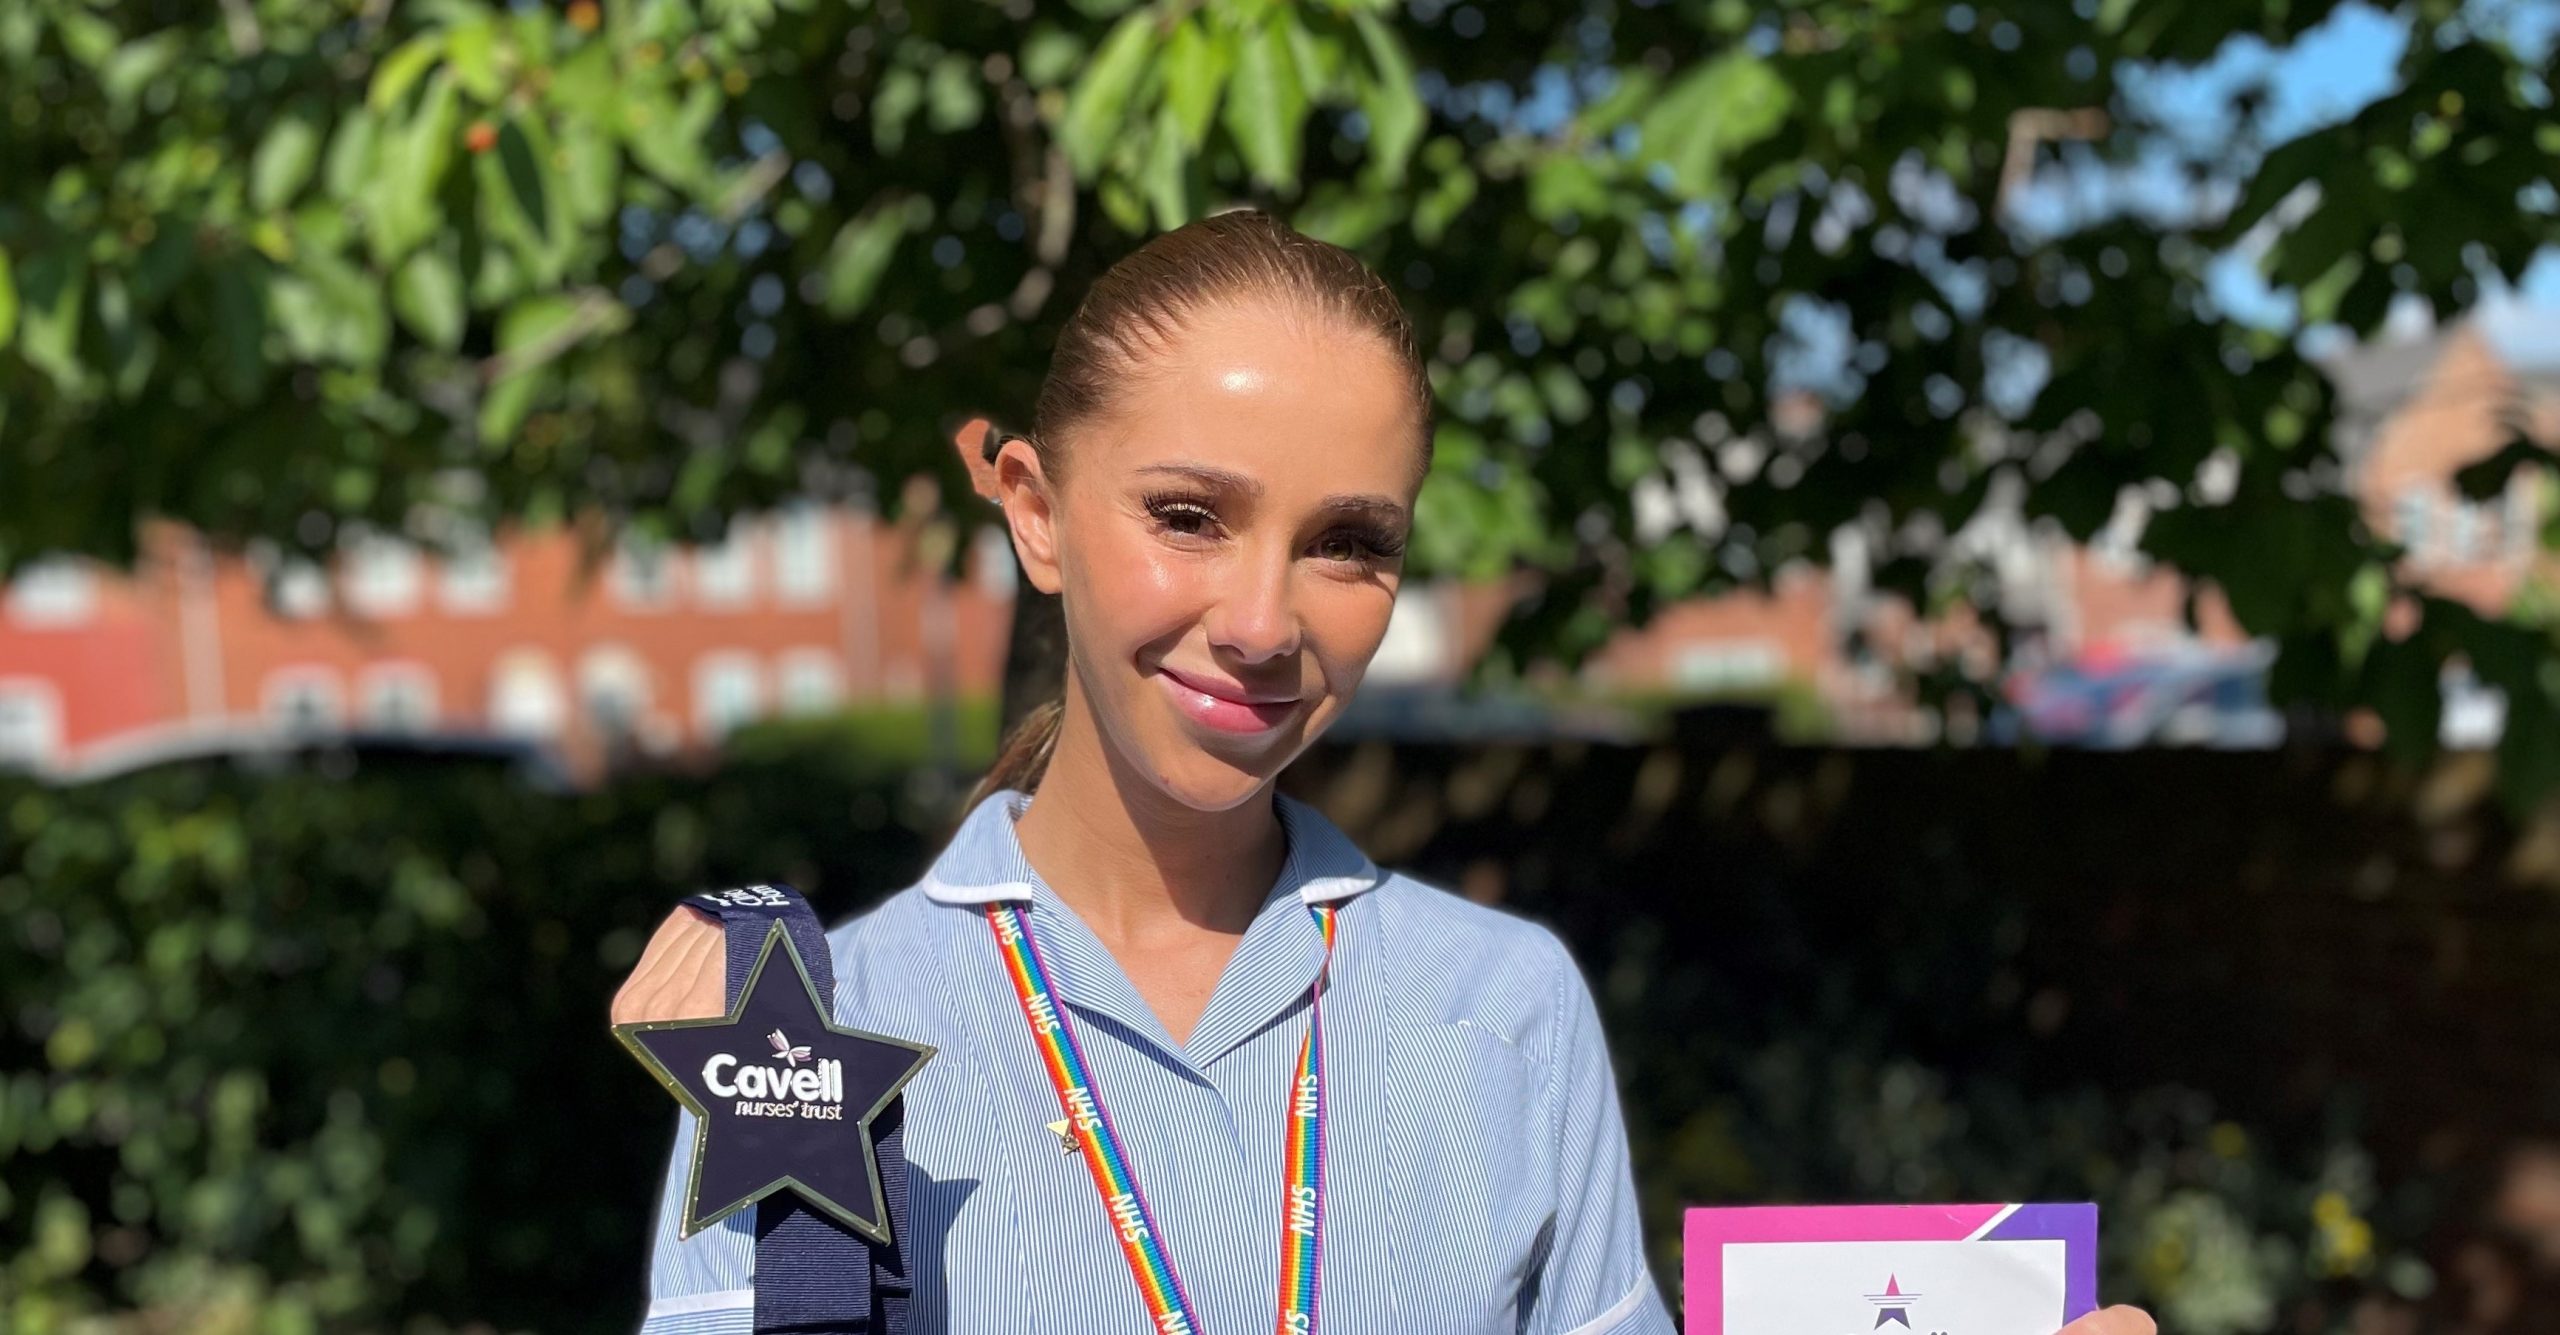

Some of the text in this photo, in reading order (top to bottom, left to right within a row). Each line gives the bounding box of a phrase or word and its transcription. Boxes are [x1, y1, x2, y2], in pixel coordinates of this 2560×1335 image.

[992, 905, 1023, 946] NHS
[1025, 992, 1060, 1035] NHS
[701, 1053, 843, 1103] Cavell
[1295, 1074, 1317, 1118] NHS
[801, 1104, 843, 1120] trust
[1064, 1086, 1103, 1131] NHS
[1109, 1193, 1149, 1243] NHS
[1290, 1184, 1316, 1237] NHS
